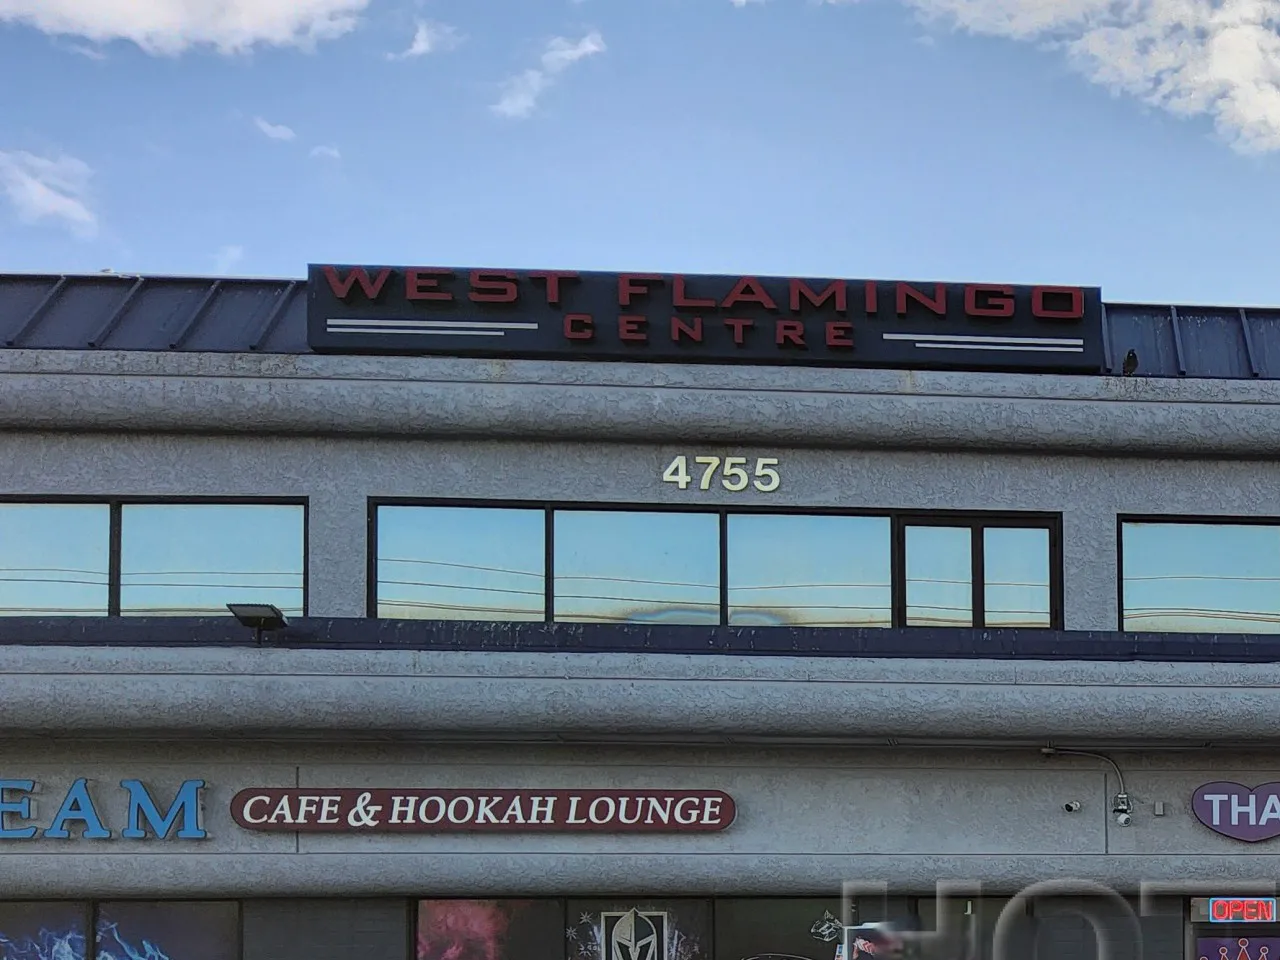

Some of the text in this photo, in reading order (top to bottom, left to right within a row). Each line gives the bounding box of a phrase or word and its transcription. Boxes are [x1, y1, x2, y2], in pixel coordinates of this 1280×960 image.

[323, 266, 1084, 318] WEST FLAMINGO
[563, 314, 855, 347] CENTRE
[662, 456, 781, 492] 4755
[0, 778, 207, 839] EAM
[242, 791, 723, 828] CAFE & HOOKAH LOUNGE
[1212, 899, 1273, 921] OPEN
